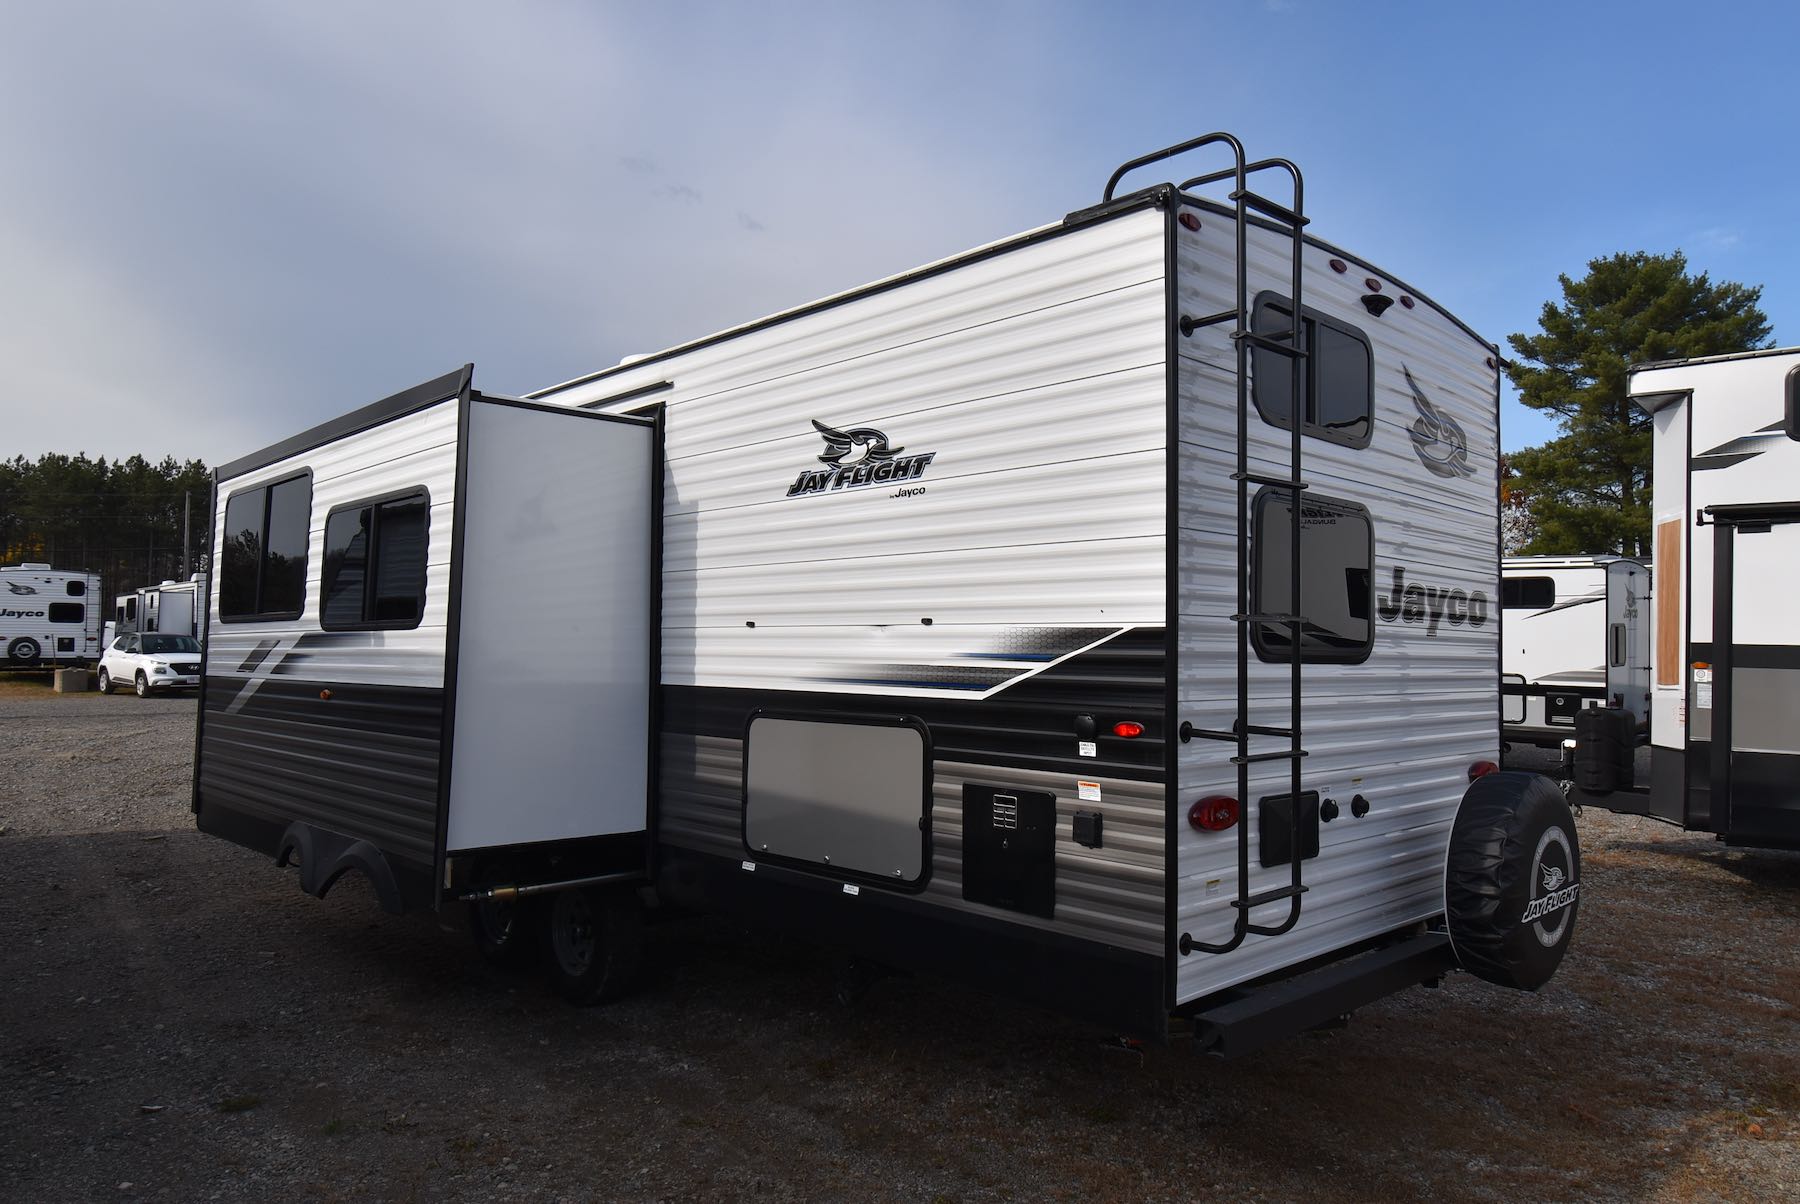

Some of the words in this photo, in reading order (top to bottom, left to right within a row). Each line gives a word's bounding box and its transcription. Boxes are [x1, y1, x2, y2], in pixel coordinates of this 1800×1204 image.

[786, 470, 838, 497] JAY
[831, 452, 936, 490] FLIGHT
[895, 486, 926, 498] Jayco
[0, 608, 45, 619] Jayco
[1377, 566, 1488, 638] Jayco
[1521, 899, 1547, 923] JAY
[1543, 884, 1579, 915] FLIGHT
